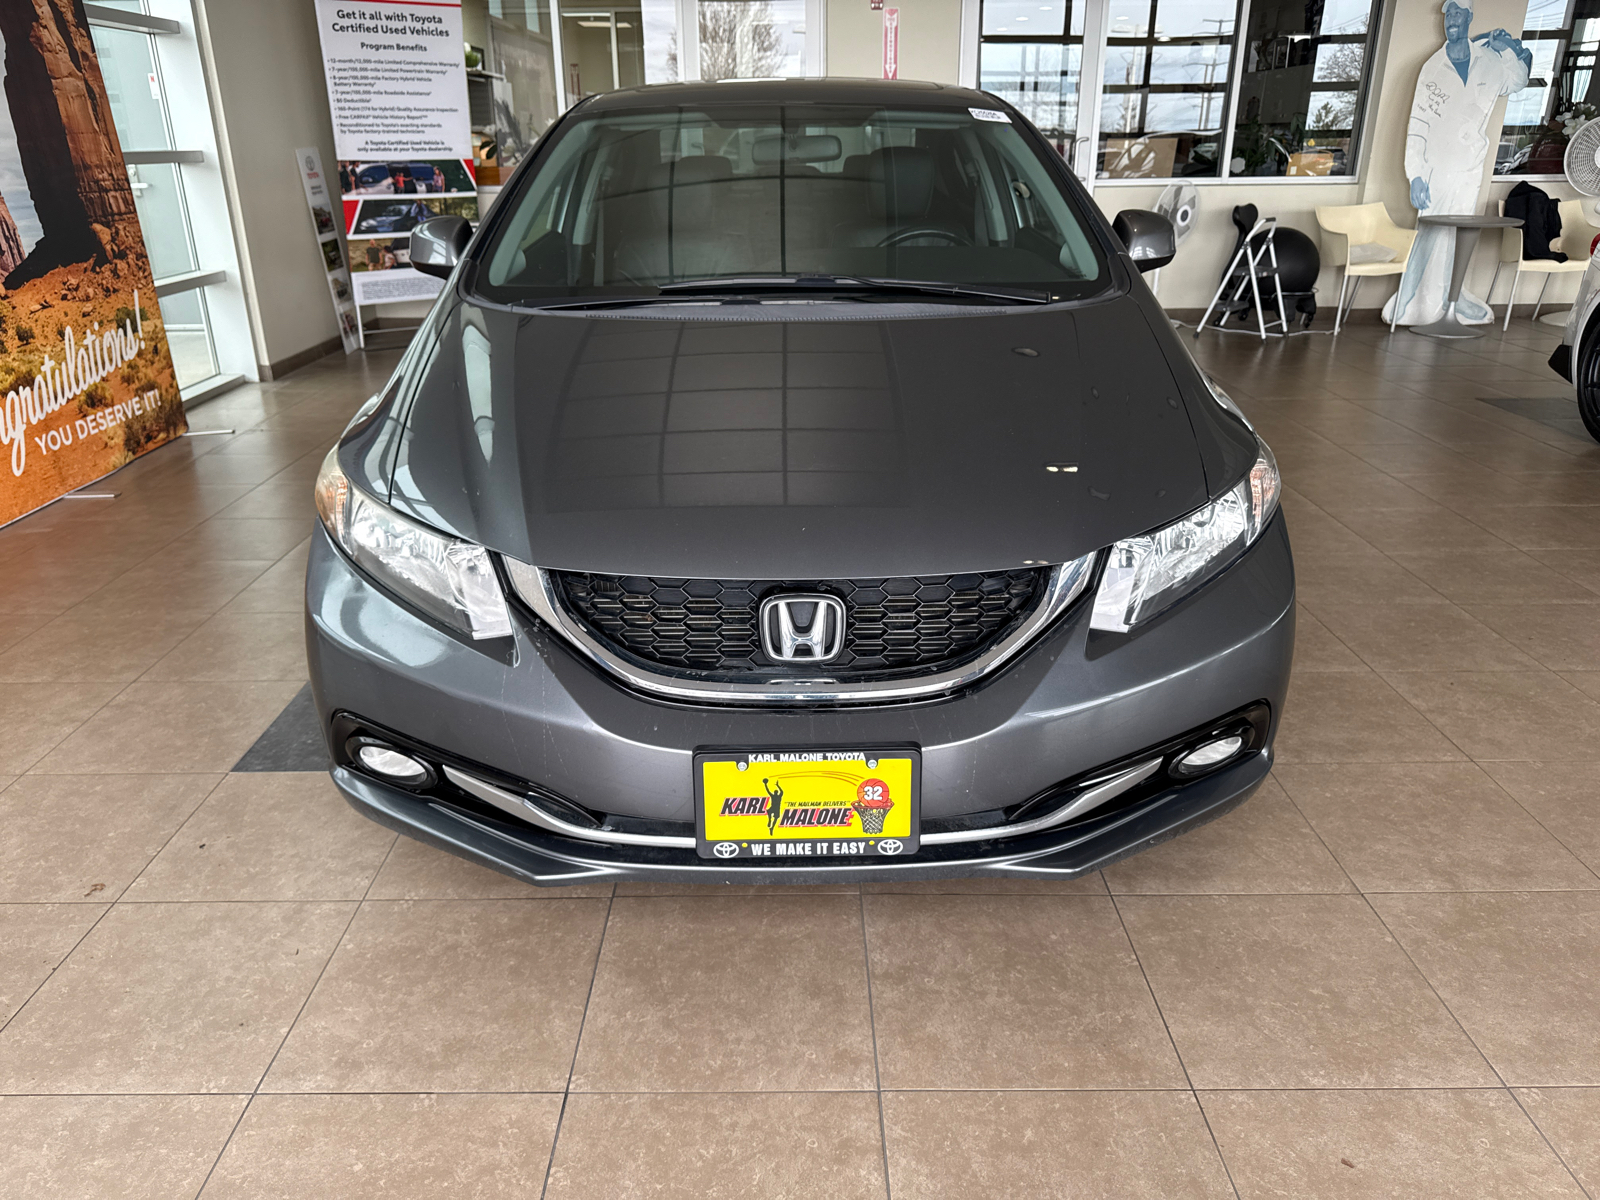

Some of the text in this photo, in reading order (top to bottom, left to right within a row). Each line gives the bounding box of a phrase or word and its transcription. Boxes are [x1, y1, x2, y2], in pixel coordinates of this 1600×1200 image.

[336, 9, 443, 25] Get it all with Toyota
[331, 22, 450, 37] Certified Used Vehicles
[360, 42, 428, 52] Program Benefits
[34, 388, 162, 455] YOU DESERVE IT!
[748, 752, 866, 763] KARL MALONE TOYOTA
[863, 785, 883, 801] 32
[719, 797, 770, 817] KARL
[778, 807, 854, 828] MALONE
[751, 841, 866, 856] WE MAKE IT EASY
